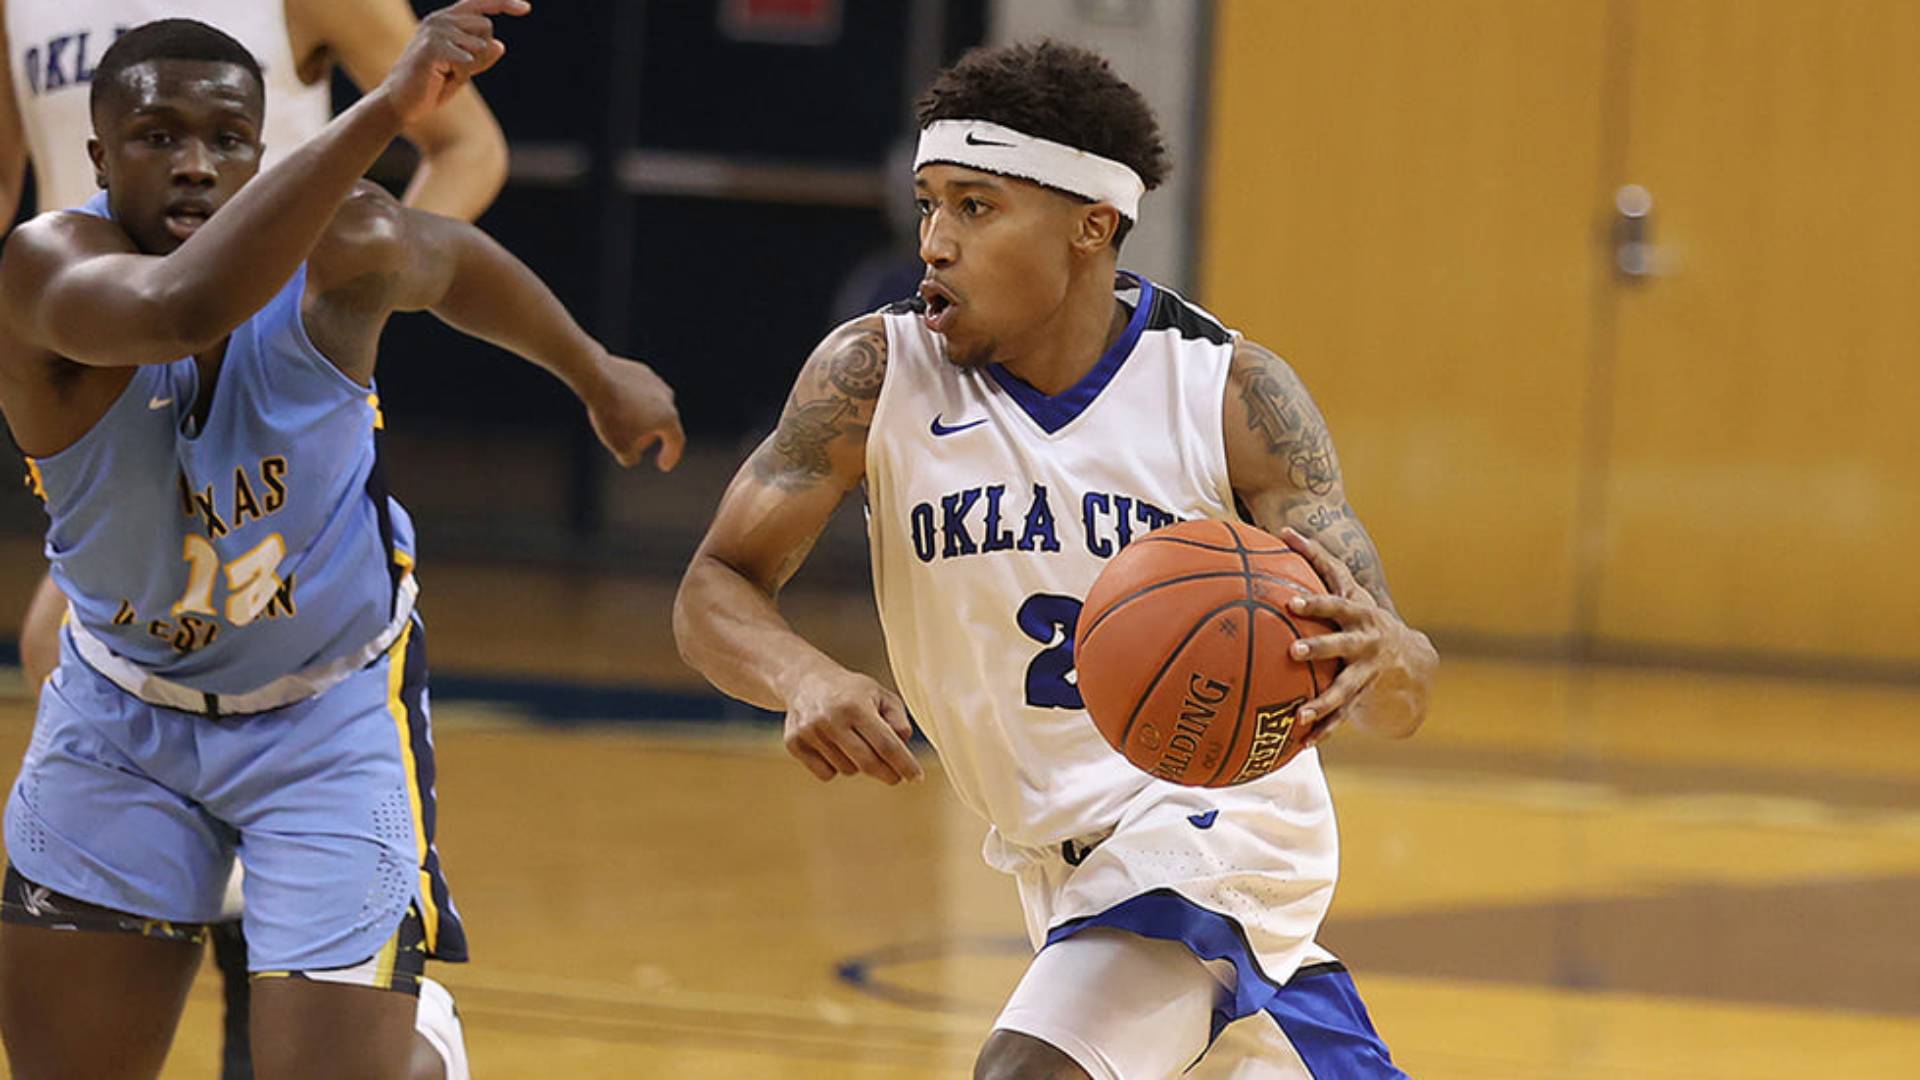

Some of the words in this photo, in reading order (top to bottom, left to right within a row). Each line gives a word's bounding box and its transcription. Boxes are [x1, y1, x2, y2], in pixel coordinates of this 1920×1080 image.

[25, 28, 127, 95] OKL
[911, 484, 1061, 562] OKLA
[1082, 491, 1187, 559] CIT
[1016, 592, 1084, 710] 2
[1155, 672, 1231, 779] ALDING
